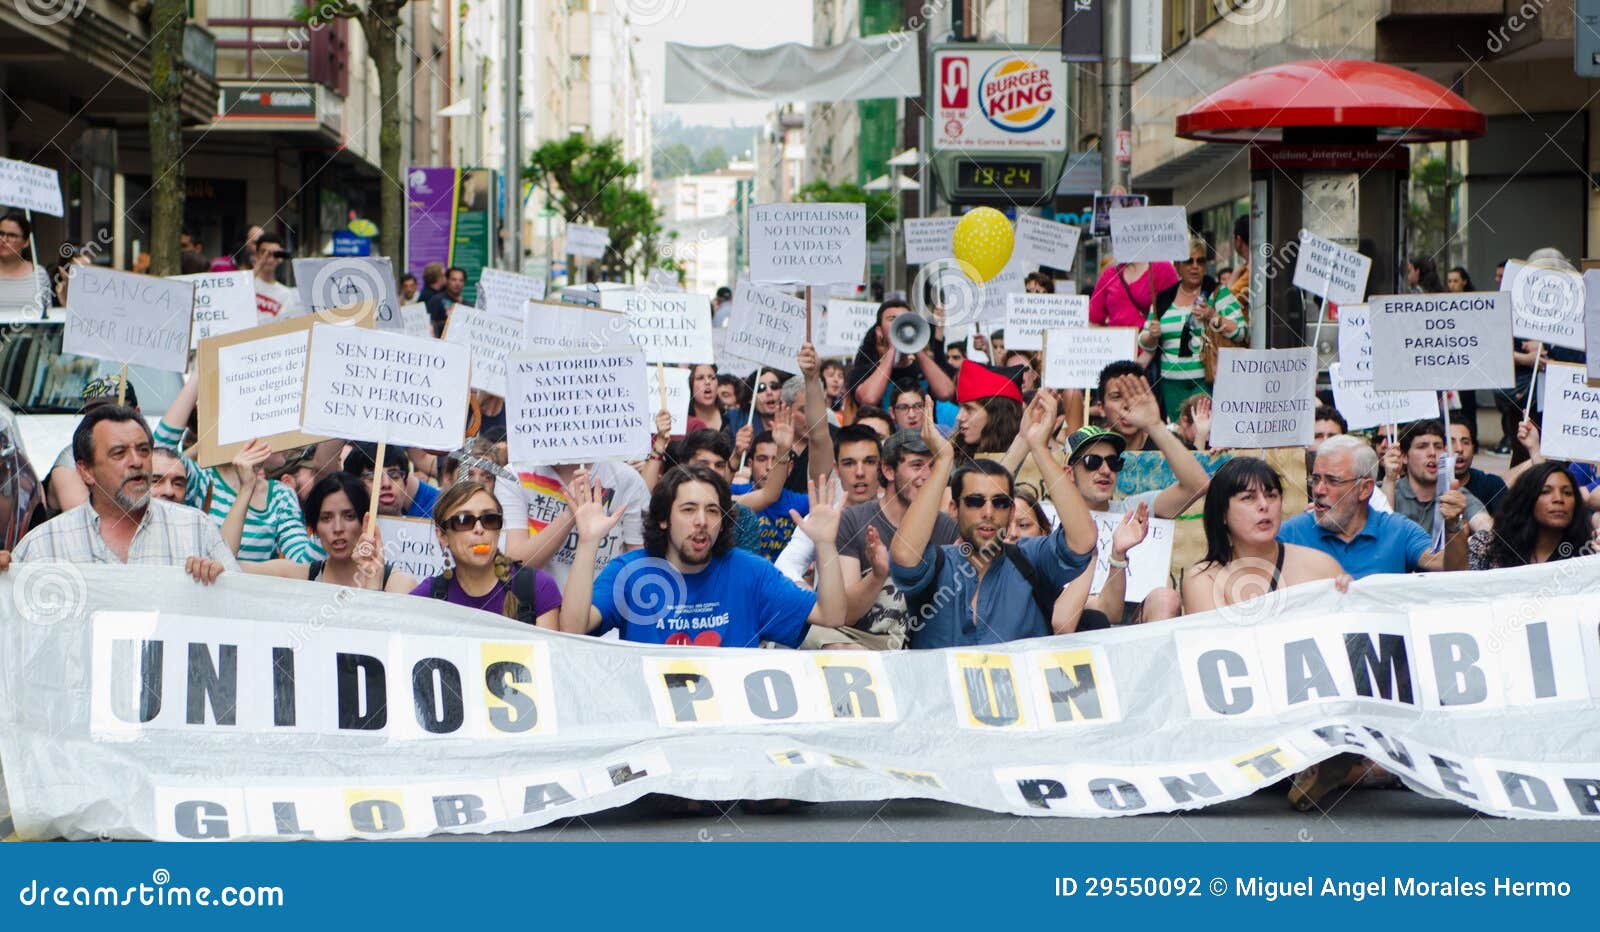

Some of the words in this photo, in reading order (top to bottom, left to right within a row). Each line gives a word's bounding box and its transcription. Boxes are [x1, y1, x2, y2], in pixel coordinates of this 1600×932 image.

[986, 69, 1049, 97] BURGER
[989, 83, 1052, 117] KING
[974, 168, 1031, 185] 19:24
[756, 211, 771, 221] EL
[774, 211, 859, 221] CAPITALISMO
[764, 226, 782, 236] NO
[786, 225, 851, 236] FUNCIONA
[1122, 224, 1130, 233] A
[774, 240, 790, 251] LA
[793, 240, 824, 251] VIDA
[827, 240, 842, 250] ES
[1311, 238, 1335, 253] STOP
[1344, 253, 1362, 267] LOS
[772, 255, 807, 265] OTRA
[809, 255, 843, 265] COSA
[1311, 252, 1356, 279] RESCATES
[195, 277, 234, 289] CATES
[331, 276, 359, 294] YA
[1306, 264, 1357, 292] BANCARIOS
[82, 273, 171, 310] BANCA
[626, 299, 647, 313] EU
[652, 301, 687, 313] NON
[1385, 297, 1495, 313] ERRADICACIÓN
[194, 311, 229, 321] RCEL
[1425, 318, 1456, 330] DOS
[70, 315, 117, 339] PODER
[1516, 319, 1575, 335] CEREBRO
[1405, 334, 1479, 348] PARAÍSOS
[260, 351, 281, 362] eres
[284, 344, 307, 357] neut
[336, 342, 368, 359] SEN
[373, 347, 446, 370] DEREITO
[1415, 352, 1470, 366] FISCÁIS
[225, 365, 282, 383] situaciones
[286, 359, 299, 371] de
[518, 363, 533, 373] AS
[536, 356, 634, 373] AUTORIDADES
[1231, 359, 1308, 374] INDIGNADOS
[345, 363, 377, 379] SEN
[383, 365, 432, 388] ÉTICA
[535, 373, 616, 388] SANITARIAS
[239, 385, 256, 396] has
[259, 376, 298, 392] elegido
[1265, 380, 1281, 394] CO
[255, 394, 271, 406] del
[274, 390, 302, 403] opres
[331, 381, 363, 398] SEN
[369, 387, 443, 409] PERMISO
[525, 391, 594, 404] ADVIRTEN
[597, 387, 630, 400] QUE:
[250, 404, 300, 422] Desmond
[324, 401, 357, 417] SEN
[362, 405, 445, 429] VERGOÑA
[573, 405, 582, 415] E
[586, 402, 635, 415] FARJAS
[1220, 399, 1310, 414] OMNIPRESENTE
[514, 423, 542, 435] SON
[546, 415, 643, 433] PERXUDICIÁIS
[1235, 419, 1297, 434] CALDEIRO
[1562, 425, 1600, 438] RESC
[532, 437, 567, 449] PARA
[570, 437, 580, 447] A
[582, 432, 627, 447] SAÚDE
[402, 541, 435, 556] POR
[656, 619, 665, 630] A
[667, 616, 690, 630] TÚA
[691, 612, 730, 630] SAÚDE
[110, 639, 538, 734] UNIDOS
[662, 665, 881, 723] POR
[965, 663, 1103, 728] UN
[1197, 617, 1600, 716] CAMBI
[174, 761, 648, 839] GLOBAL
